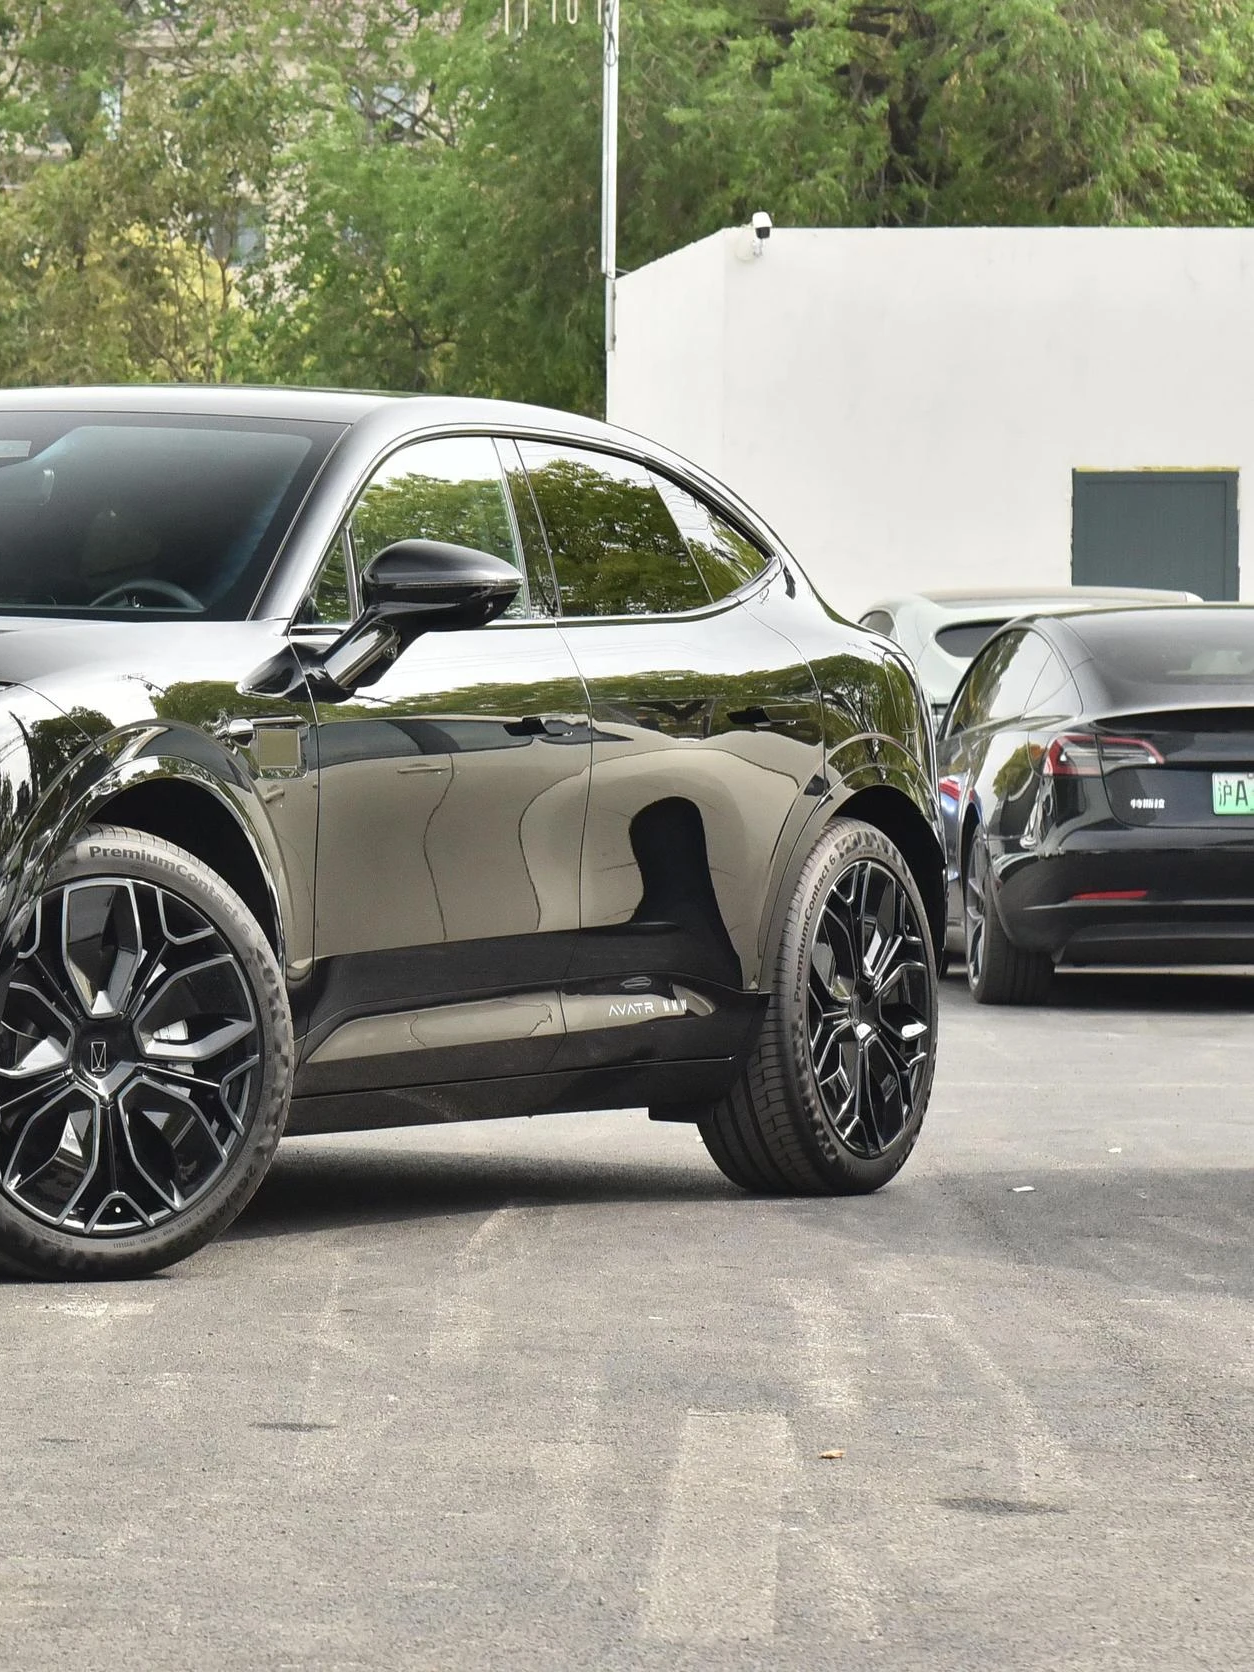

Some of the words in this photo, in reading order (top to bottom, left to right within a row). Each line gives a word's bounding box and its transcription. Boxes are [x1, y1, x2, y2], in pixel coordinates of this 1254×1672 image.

[89, 846, 239, 921] PremiumContact
[794, 864, 829, 1002] PremiumContact
[829, 854, 836, 865] 6
[609, 1001, 655, 1017] AVATR
